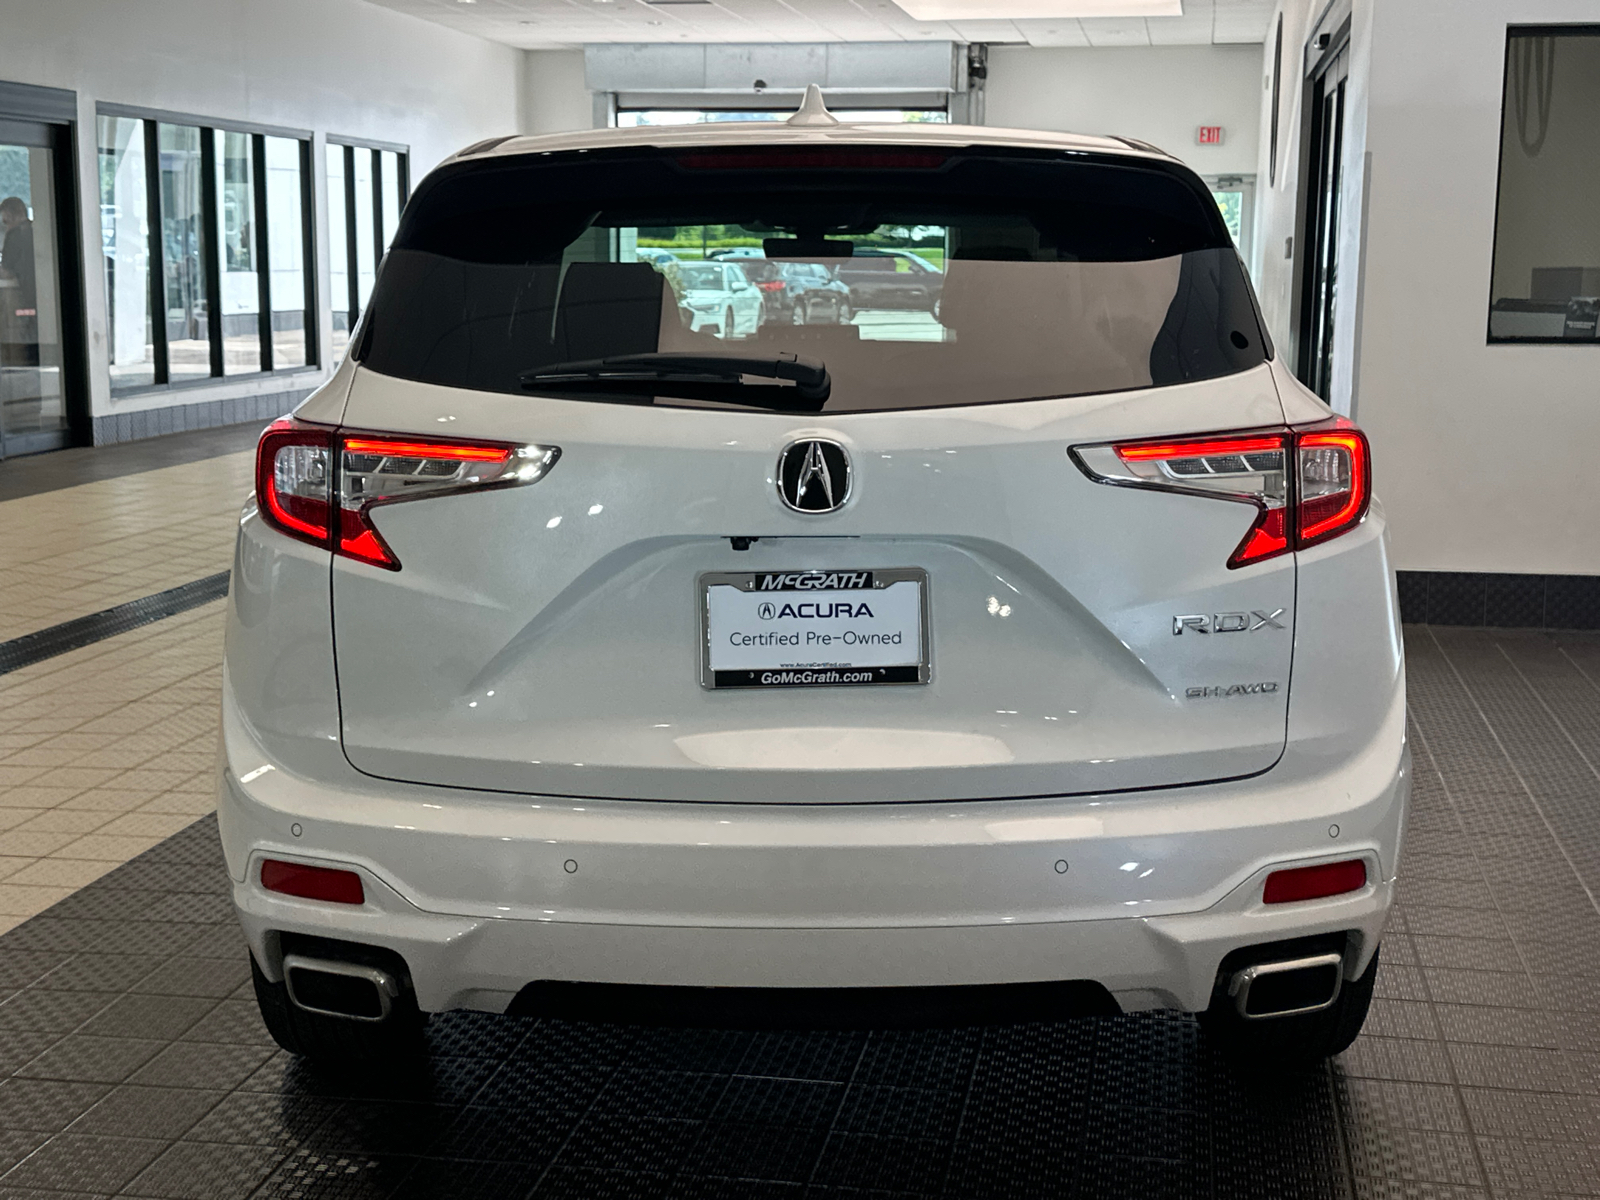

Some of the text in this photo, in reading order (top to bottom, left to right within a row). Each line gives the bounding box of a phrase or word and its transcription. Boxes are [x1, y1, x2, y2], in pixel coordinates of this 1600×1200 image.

[1199, 126, 1221, 143] EXIT
[777, 602, 875, 619] ACURA
[1172, 607, 1287, 636] RDX
[729, 630, 902, 647] Certified Pre-Owned
[760, 670, 873, 685] GoMcGrath.com
